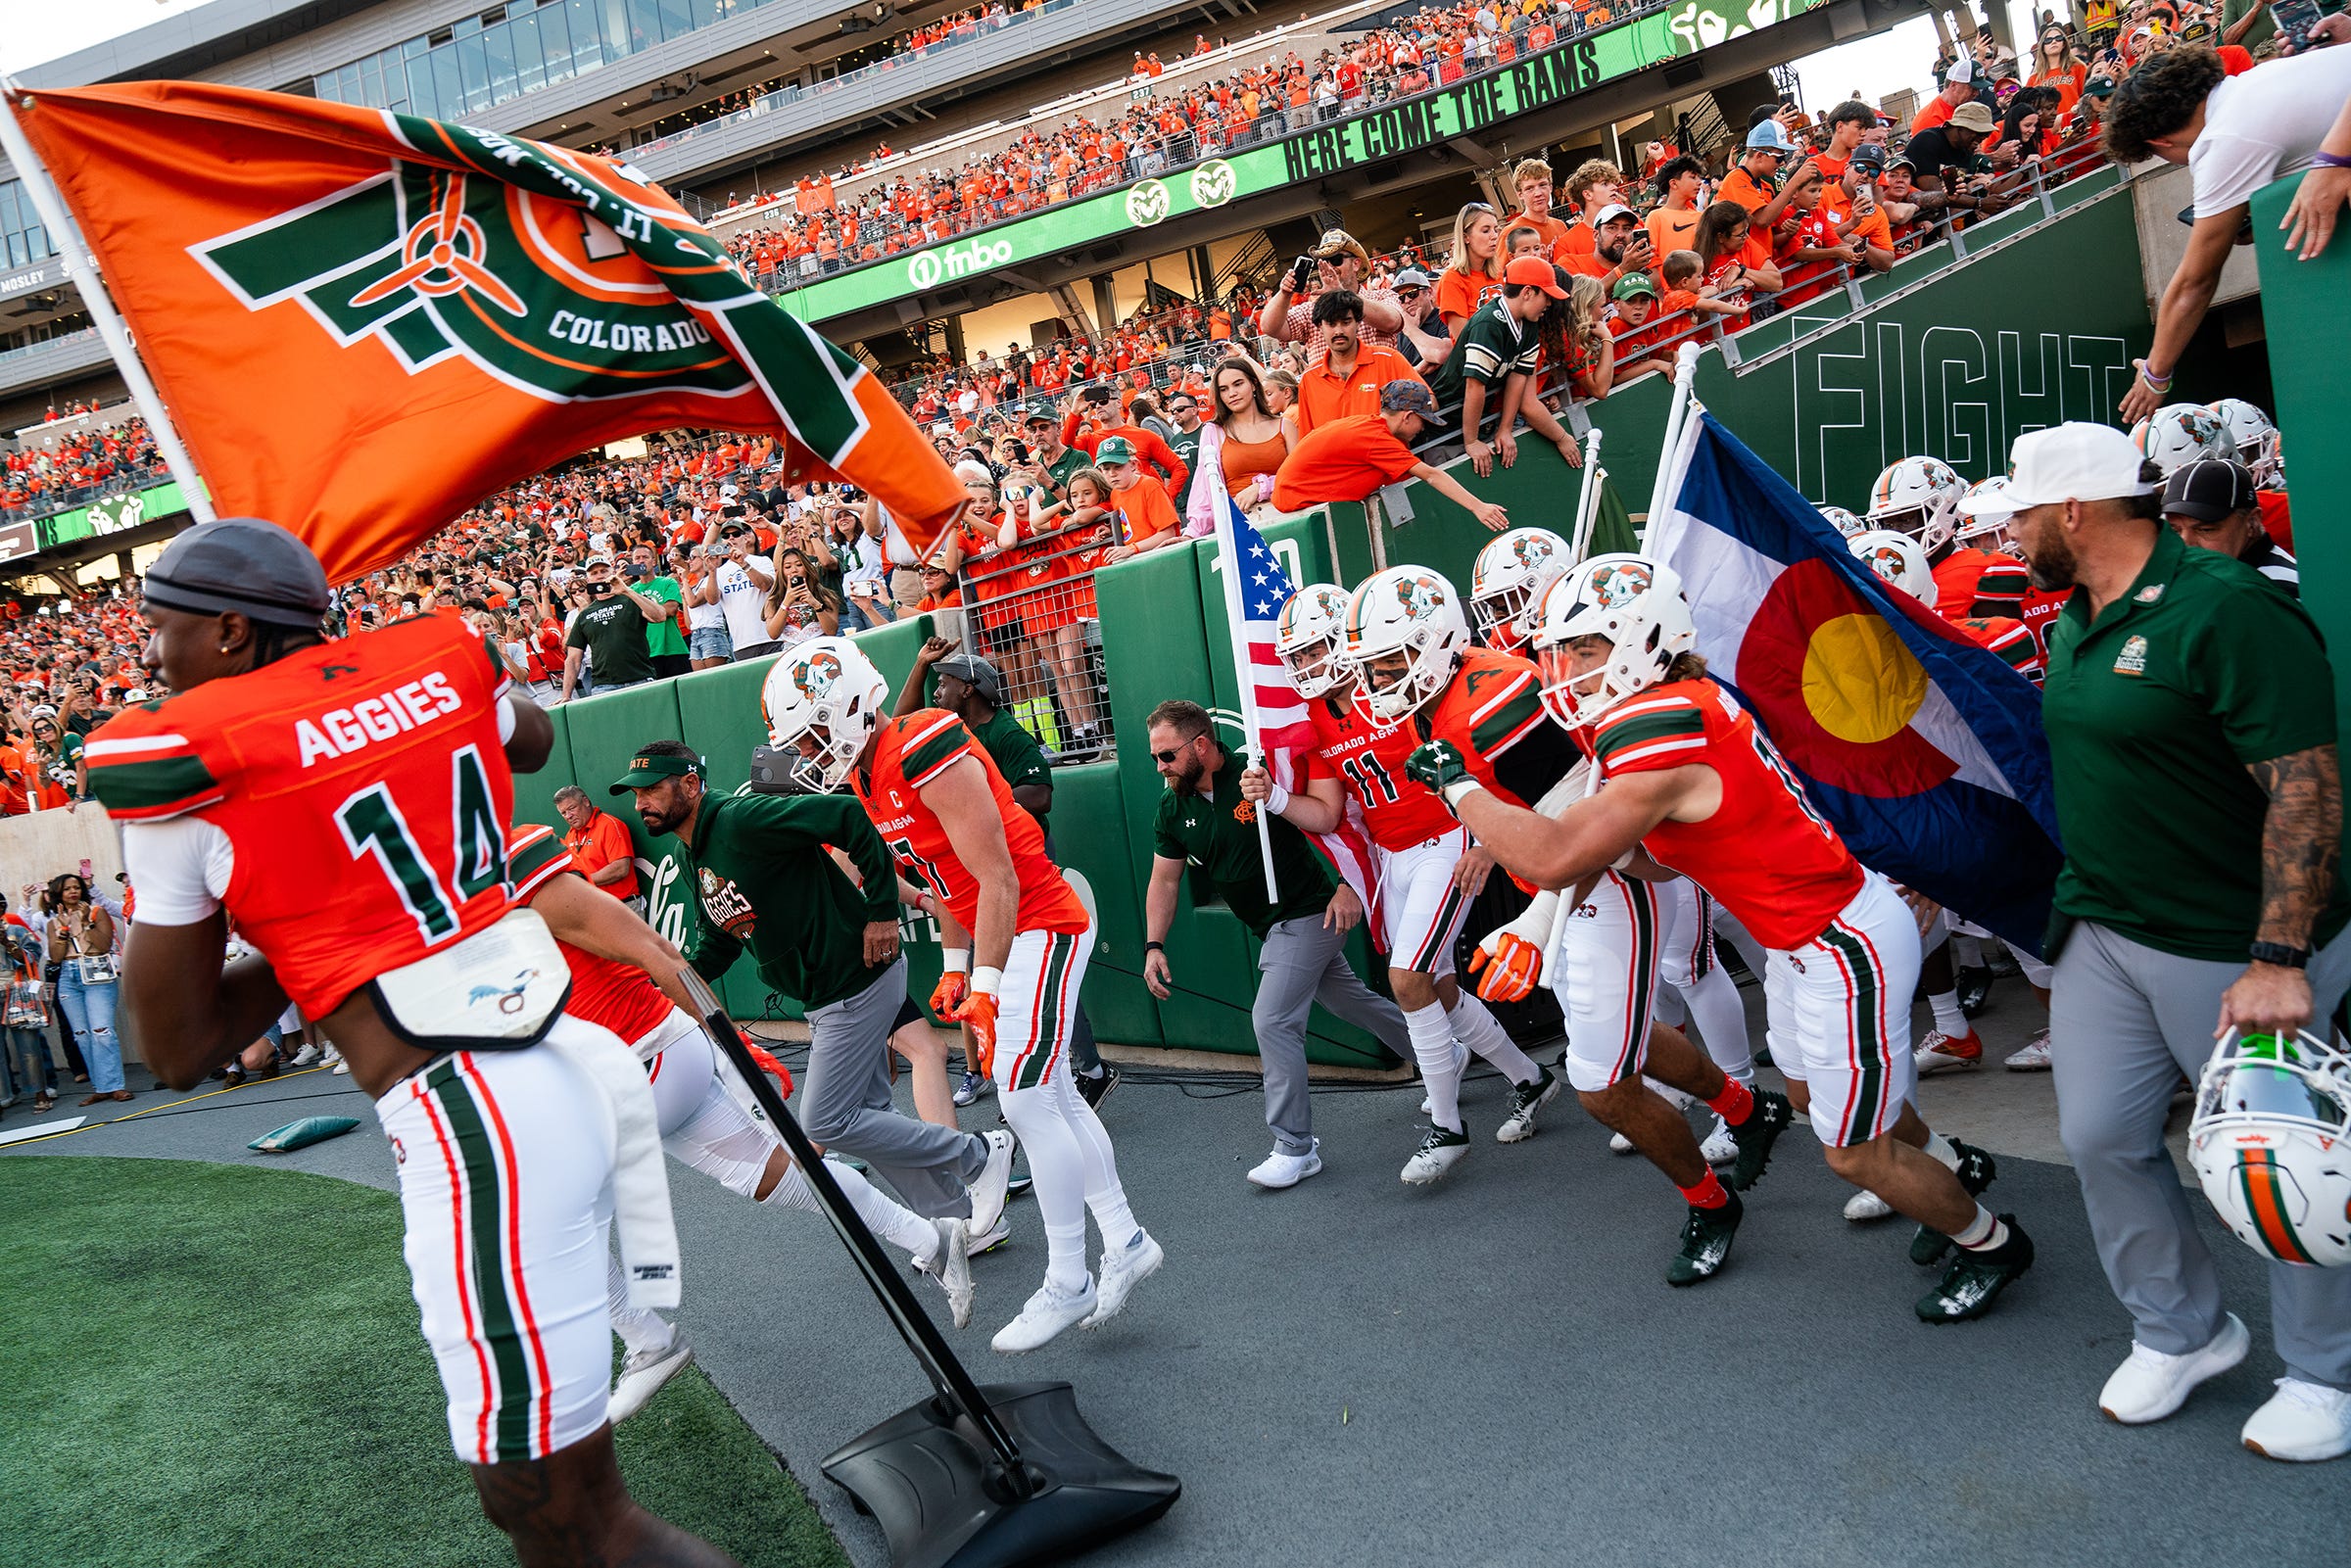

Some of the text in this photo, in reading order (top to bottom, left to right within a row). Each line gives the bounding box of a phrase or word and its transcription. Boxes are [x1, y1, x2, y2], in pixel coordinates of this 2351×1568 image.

[1132, 86, 1150, 100] 237
[2040, 75, 2075, 88] GGIES
[1284, 41, 1601, 182] HERE COME THE RAMS
[609, 202, 653, 244] LT.
[764, 208, 780, 219] 236
[944, 239, 1013, 277] fnbo
[549, 309, 711, 353] COLORADO
[1792, 316, 2127, 505] FIGHT
[723, 580, 755, 594] STATE
[586, 604, 623, 619] COLORADO
[295, 672, 461, 768] AGGIES
[1369, 727, 1399, 742] A&M
[1342, 749, 1400, 809] 11
[888, 789, 903, 809] C
[892, 814, 916, 831] A&M
[333, 743, 516, 947] 14
